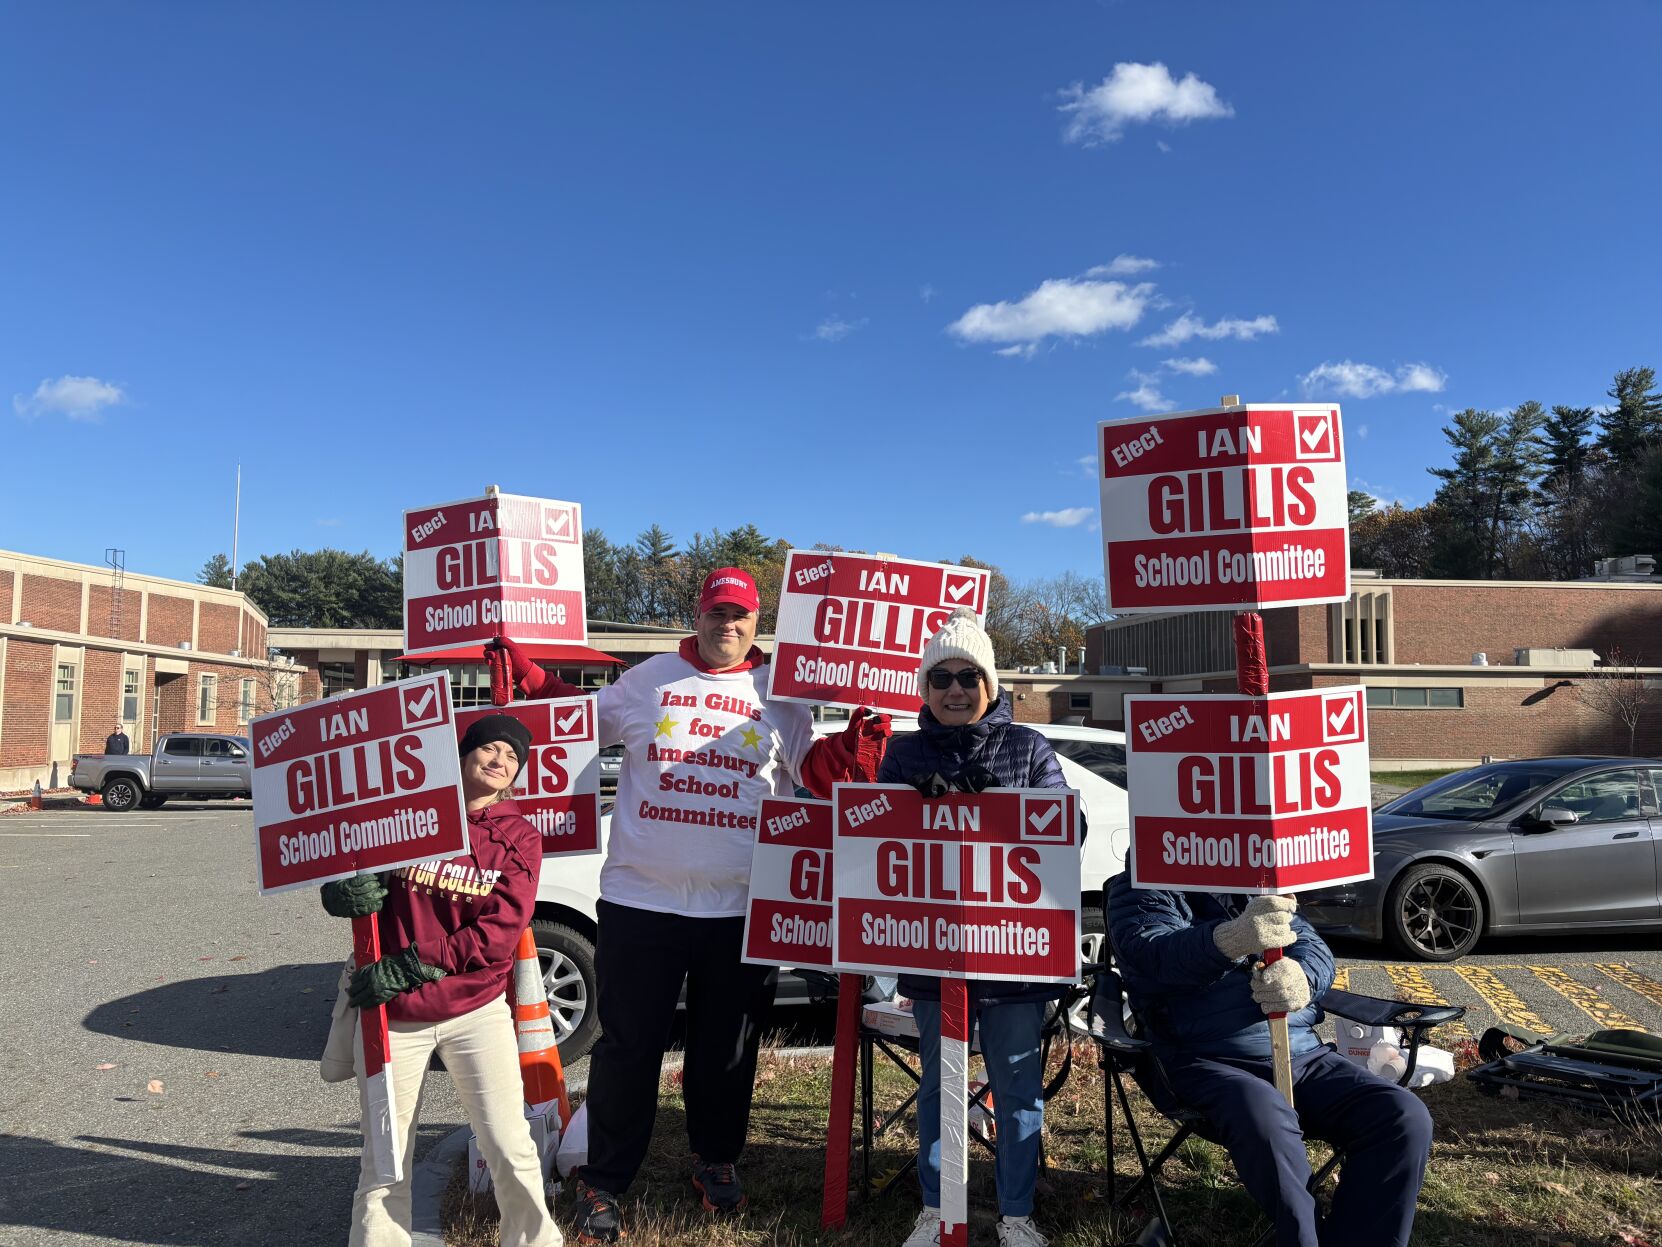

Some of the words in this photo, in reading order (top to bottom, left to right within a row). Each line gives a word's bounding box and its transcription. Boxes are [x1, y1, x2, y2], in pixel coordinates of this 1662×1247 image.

[1110, 425, 1164, 468] Elect
[1197, 425, 1262, 458] IAN
[1147, 466, 1316, 534] GILLIS
[411, 511, 447, 543] Elect
[436, 540, 558, 591] GILLIS
[710, 576, 748, 589] AMESBURY
[794, 559, 835, 586] Elect
[859, 570, 909, 595] IAN
[1134, 550, 1210, 587] School
[1217, 544, 1325, 583] Committee
[425, 600, 477, 632] School
[482, 597, 566, 625] Committee
[794, 655, 854, 688] School
[857, 663, 920, 696] Commi
[660, 691, 697, 707] Ian
[704, 693, 762, 721] Gillis
[1138, 704, 1194, 743] Elect
[1229, 712, 1291, 742] IAN
[258, 718, 301, 757] Elect
[319, 708, 369, 741] IAN
[689, 718, 725, 739] for
[286, 734, 427, 815] GILLIS
[648, 743, 759, 779] Amesbury
[659, 773, 739, 799] School
[1177, 748, 1341, 816] GILLIS
[522, 809, 576, 836] ittee
[639, 800, 758, 829] Committee
[767, 806, 811, 837] Elect
[844, 793, 892, 828] Elect
[922, 803, 981, 831] IAN
[279, 824, 336, 867] School
[339, 807, 439, 854] Committee
[1162, 830, 1241, 867] School
[1247, 826, 1350, 868] Committee
[438, 863, 502, 896] COLLEGE
[876, 840, 1041, 905] GILLIS
[402, 881, 472, 903] EAGLES
[770, 912, 833, 948] School
[861, 912, 928, 949] School
[935, 916, 1049, 956] Committee
[1348, 1049, 1371, 1057] DUNKI
